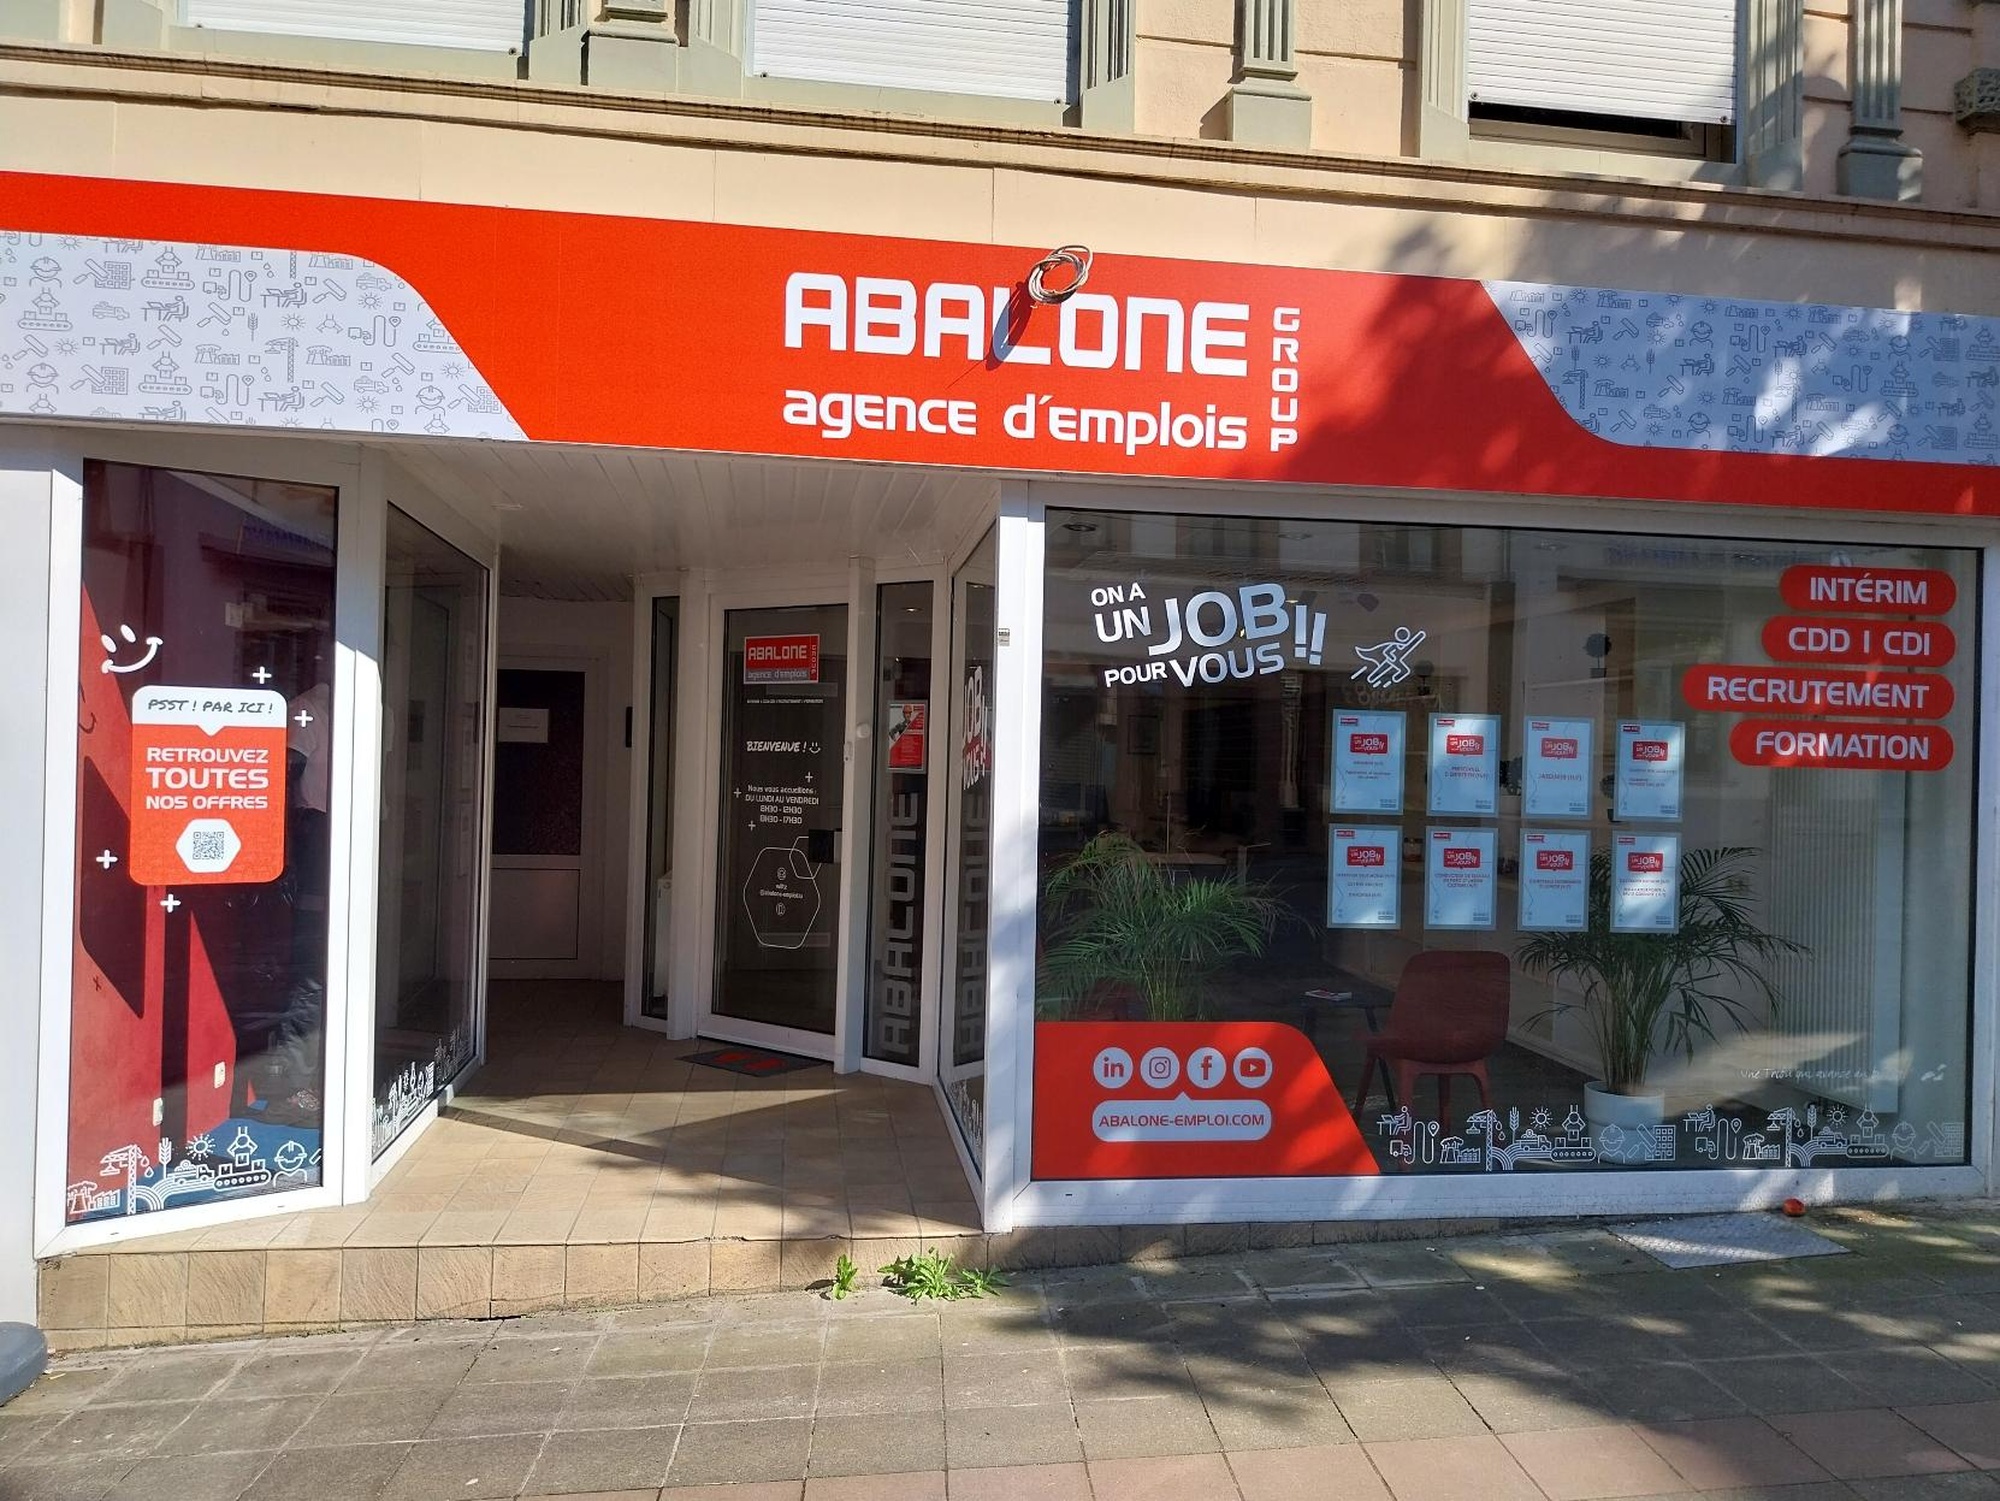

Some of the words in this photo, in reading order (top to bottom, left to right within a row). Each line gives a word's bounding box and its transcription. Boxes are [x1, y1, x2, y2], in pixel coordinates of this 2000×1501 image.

[785, 272, 1250, 376] ABALONE
[1271, 306, 1301, 452] GROUP
[783, 389, 978, 439] agence
[1090, 585, 1125, 607] ON
[1128, 582, 1146, 602] A
[1810, 572, 1928, 605] INTÉRIM
[1094, 606, 1151, 643] UN
[1148, 582, 1291, 657] JOB
[748, 645, 807, 660] ABALONE
[1788, 626, 1850, 652] CDD
[1883, 631, 1930, 656] CDI
[1104, 662, 1167, 688] POUR
[1169, 642, 1285, 688] VOUS
[148, 699, 190, 712] PSST
[202, 700, 233, 713] PAR
[238, 702, 264, 713] ICI
[1707, 676, 1929, 709] RECRUTEMENT
[146, 747, 269, 764] RETROUVEZ
[746, 741, 801, 753] BIENVENUE
[1756, 731, 1929, 760] FORMATION
[146, 767, 269, 790] TOUTES
[146, 795, 188, 810] NOS
[193, 796, 268, 810] OFFRES
[786, 796, 819, 805] VENDREDI
[877, 792, 921, 1055] ABALONE
[1099, 1113, 1265, 1129] ABALONE-EMPLOI.COM
